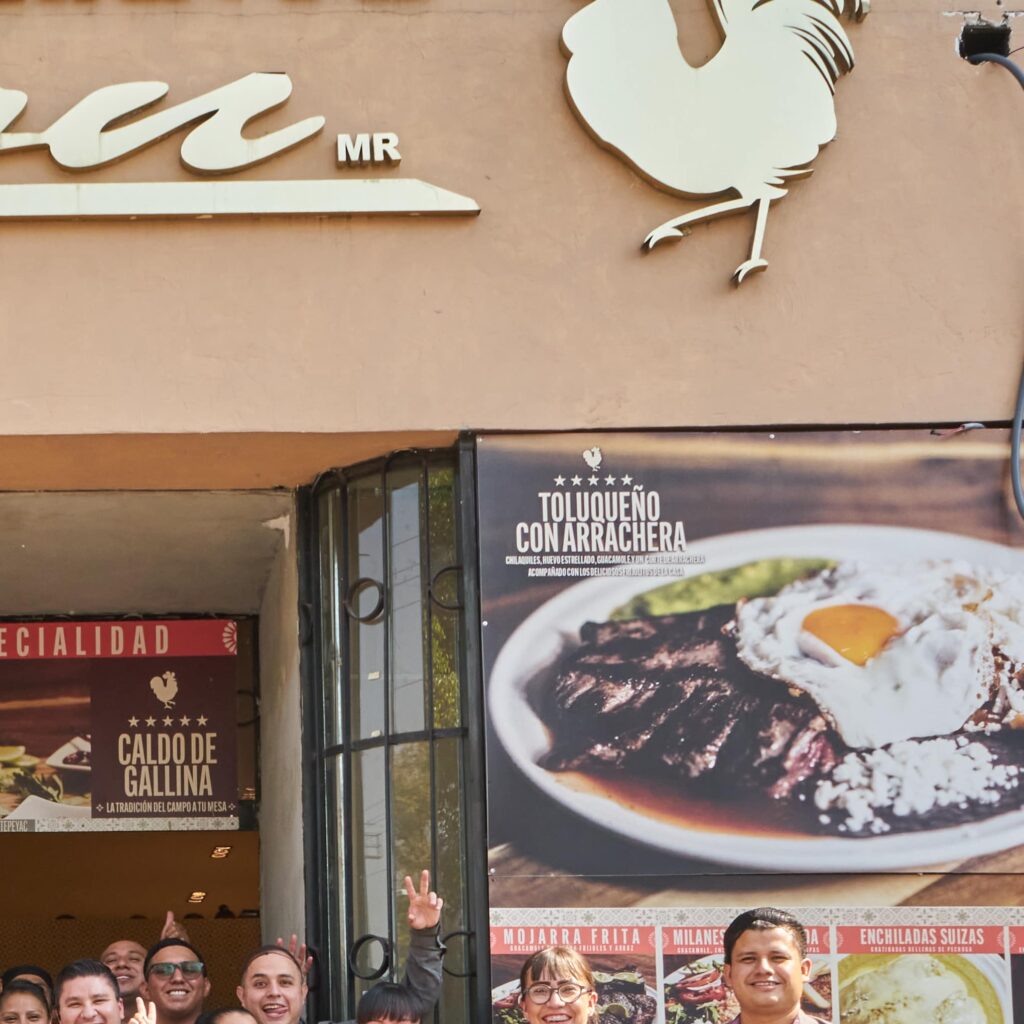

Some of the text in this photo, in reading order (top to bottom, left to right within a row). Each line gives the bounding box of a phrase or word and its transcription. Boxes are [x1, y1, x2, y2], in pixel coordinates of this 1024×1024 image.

[336, 132, 401, 168] MR
[538, 485, 661, 523] TOLUQUEÑO
[516, 521, 687, 553] CON ARRACHERA
[118, 733, 217, 765] CALDO DE
[124, 765, 213, 797] GALLINA
[106, 800, 227, 813] LA TRADICIÓN DEL CAMPO A TU MESA
[0, 820, 28, 832] TEPEYAC
[503, 928, 640, 945] MOJARRA FRITA
[673, 928, 725, 946] MILANES
[860, 928, 985, 945] ENCHILADAS SUIZAS
